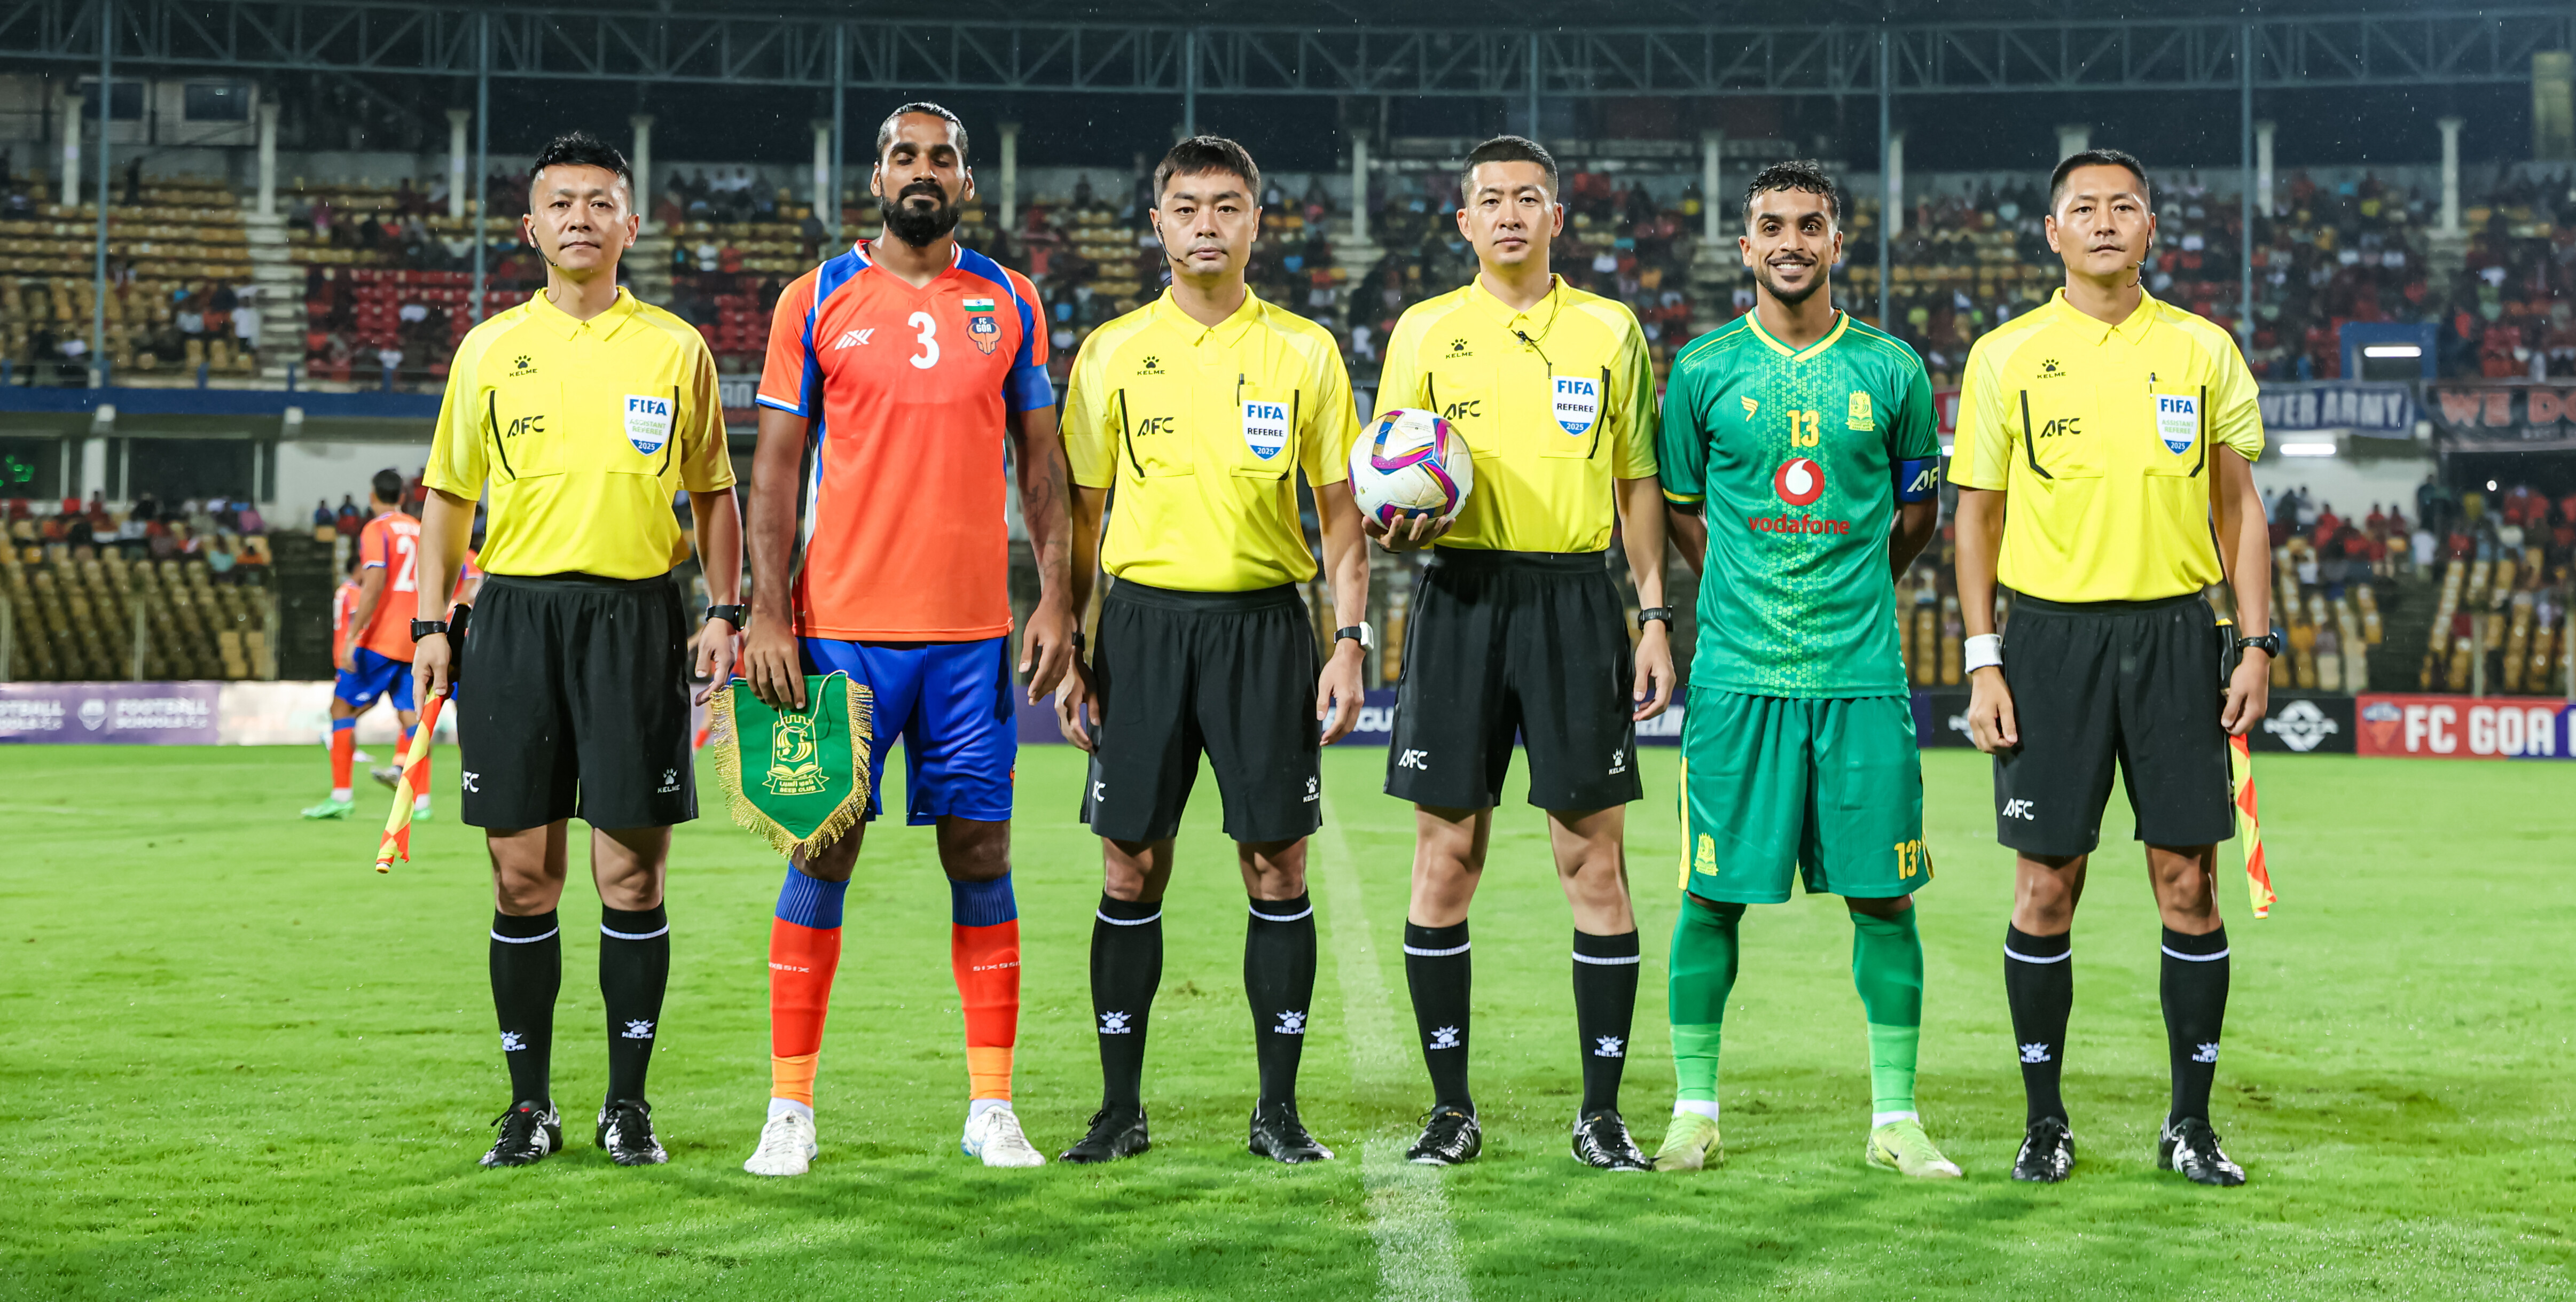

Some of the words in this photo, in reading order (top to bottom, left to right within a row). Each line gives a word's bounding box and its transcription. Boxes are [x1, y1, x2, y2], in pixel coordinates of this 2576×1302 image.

[976, 324, 992, 332] GOA
[908, 311, 940, 369] 3
[509, 368, 538, 377] KELME
[1557, 380, 1594, 396] FIFA
[629, 399, 667, 416] FIFA
[1443, 400, 1481, 420] AFC
[1557, 403, 1594, 413] REFEREE
[2160, 399, 2194, 414] FIFA
[1247, 404, 1284, 420] FIFA
[506, 415, 545, 438] AFC
[629, 418, 667, 429] ASSISTANT
[1137, 417, 1175, 437] AFC
[1566, 423, 1584, 431] 2025
[1786, 409, 1820, 448] 13
[2039, 418, 2081, 439] AFC
[2162, 419, 2194, 428] ASSISTANT
[632, 426, 663, 436] REFEREE
[1247, 427, 1284, 437] REFEREE
[2164, 427, 2191, 435] REFEREE
[638, 442, 655, 450] 2025
[1257, 447, 1274, 455] 2025
[2171, 442, 2186, 450] 2025
[1748, 513, 1850, 535] vodafone
[2405, 705, 2457, 754] FC
[2468, 705, 2556, 756] GOA
[1398, 748, 1428, 770] AFC
[1609, 766, 1625, 775] KELME
[462, 770, 480, 793] FC
[657, 784, 680, 793] KELME
[2002, 798, 2034, 821] AFC
[1894, 839, 1917, 880] 13
[622, 1031, 653, 1039] KELME
[1430, 1040, 1460, 1050] KELME
[1594, 1049, 1623, 1058] KELME
[2021, 1054, 2051, 1063] KELME
